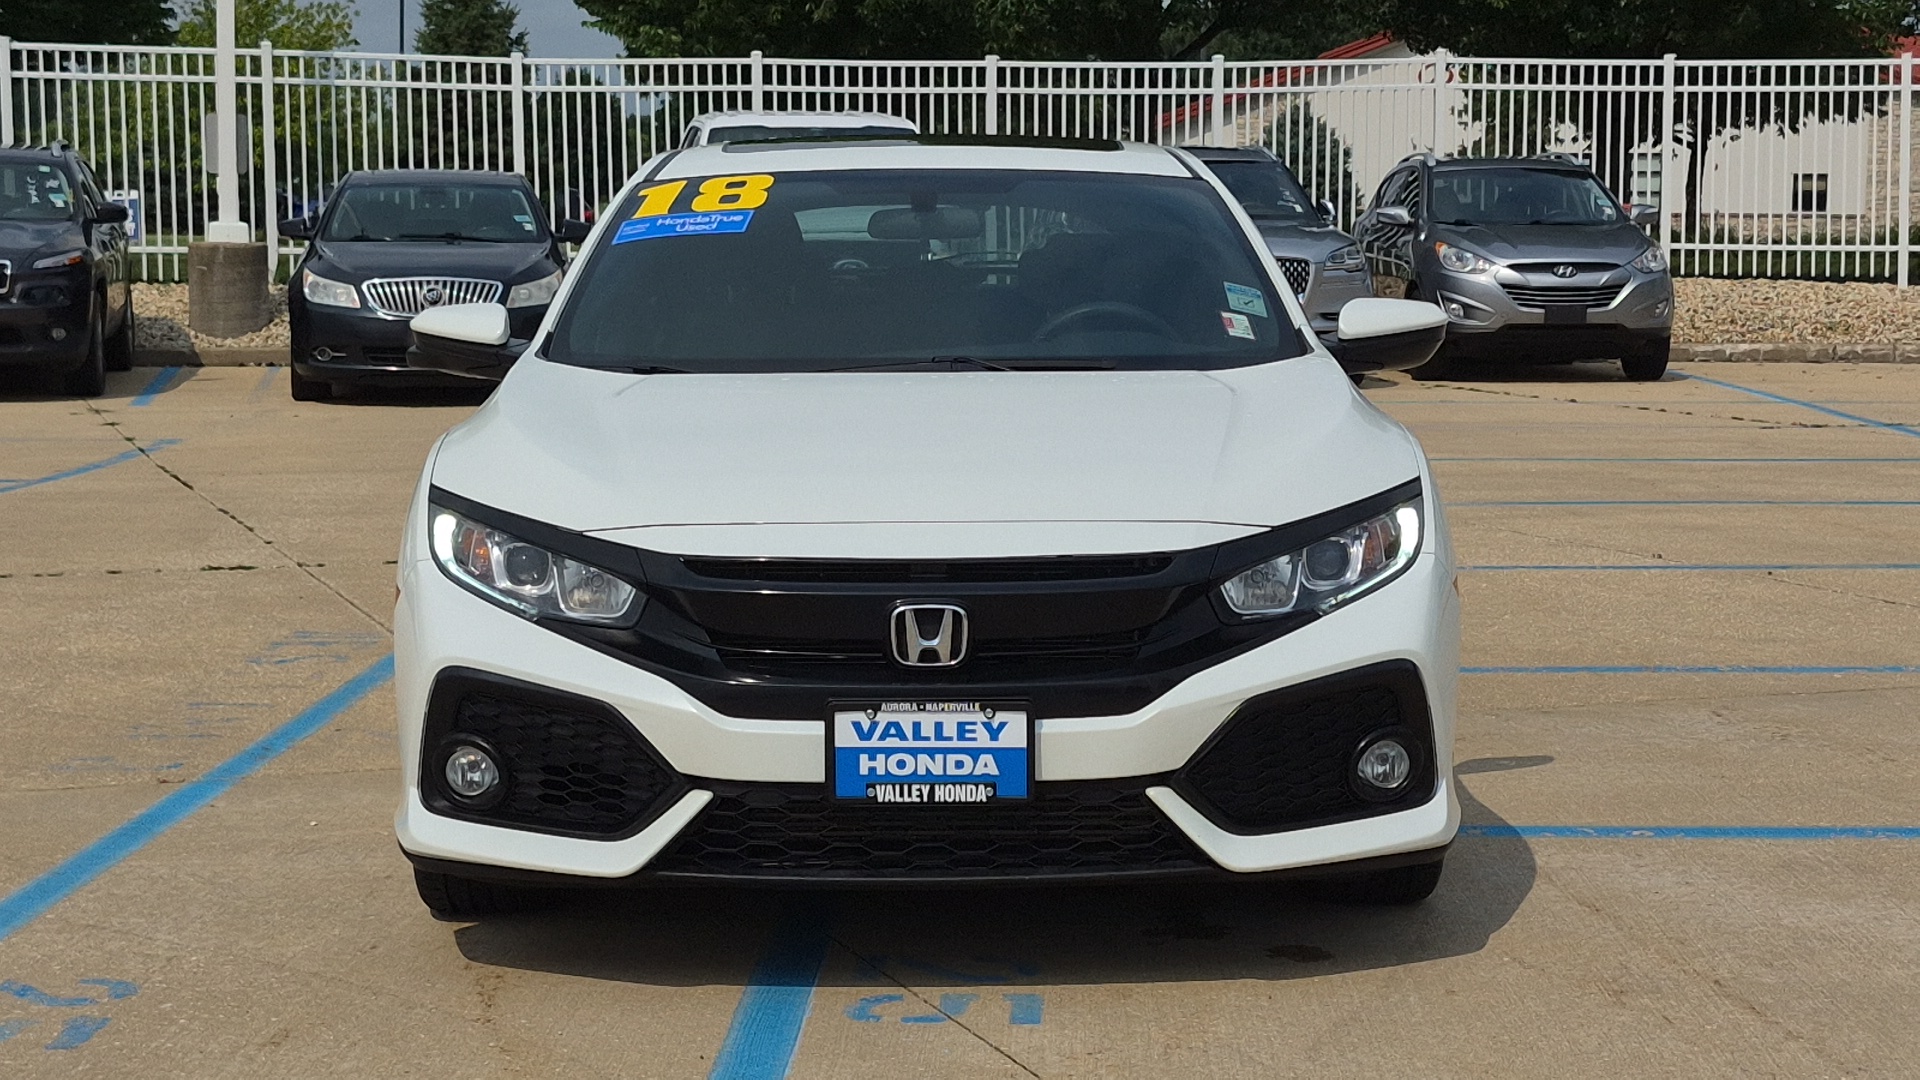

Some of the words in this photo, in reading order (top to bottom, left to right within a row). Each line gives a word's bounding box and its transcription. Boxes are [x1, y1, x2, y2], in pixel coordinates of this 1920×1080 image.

[631, 174, 775, 219] 18
[656, 214, 744, 227] HondaTrue
[675, 221, 718, 232] Used
[881, 702, 918, 712] AURORA
[925, 702, 980, 712] NAPERVILLE
[851, 721, 1009, 742] VALLEY
[859, 753, 1000, 776] HONDA
[875, 783, 930, 803] VALLEY
[934, 783, 988, 803] HONDA
